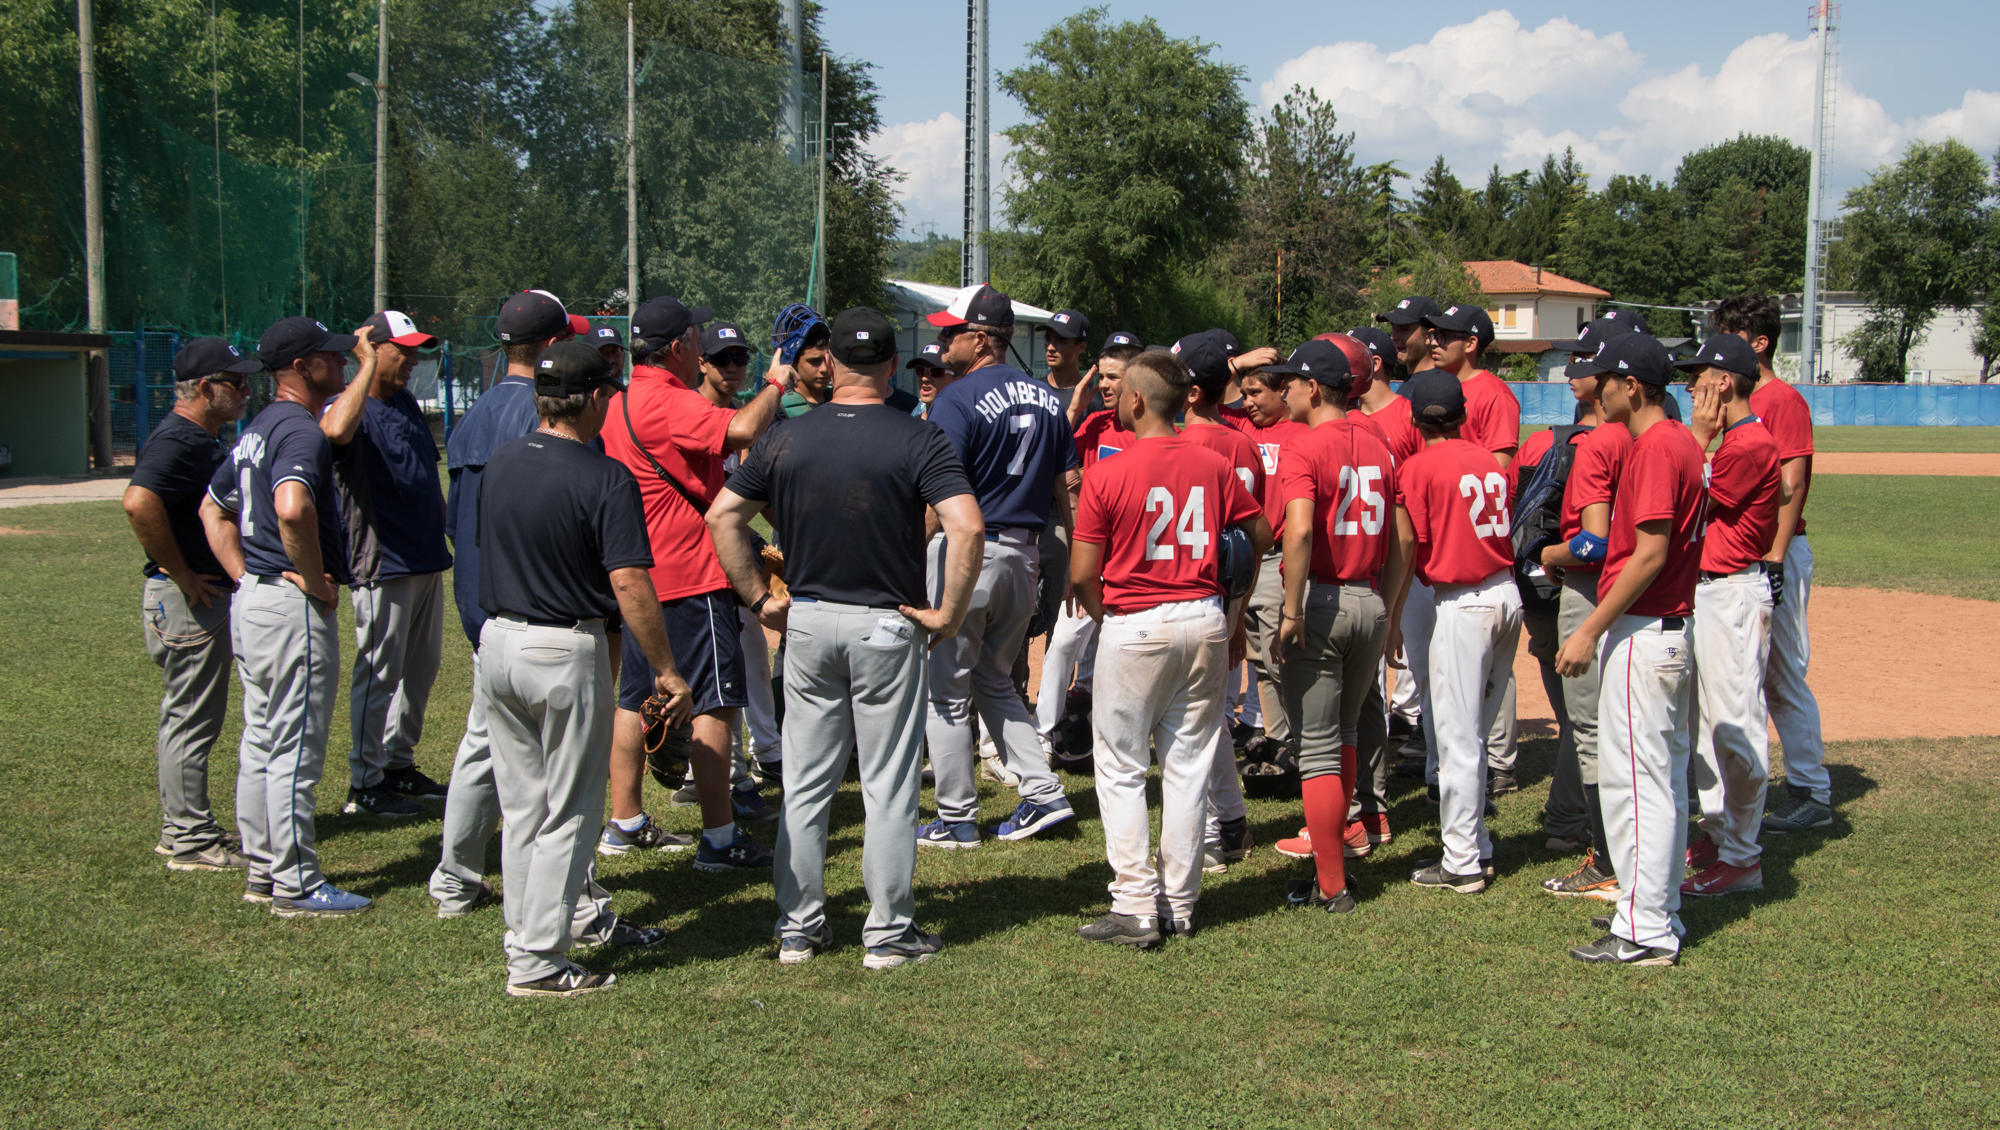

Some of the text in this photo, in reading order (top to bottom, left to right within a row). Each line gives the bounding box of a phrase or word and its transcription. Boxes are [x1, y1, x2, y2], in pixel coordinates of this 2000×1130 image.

[975, 381, 1060, 424] HOLMBERG
[1007, 413, 1036, 475] 7
[240, 467, 254, 536] 1
[1146, 486, 1210, 561] 24
[1334, 465, 1386, 536] 25
[1459, 472, 1511, 540] 23
